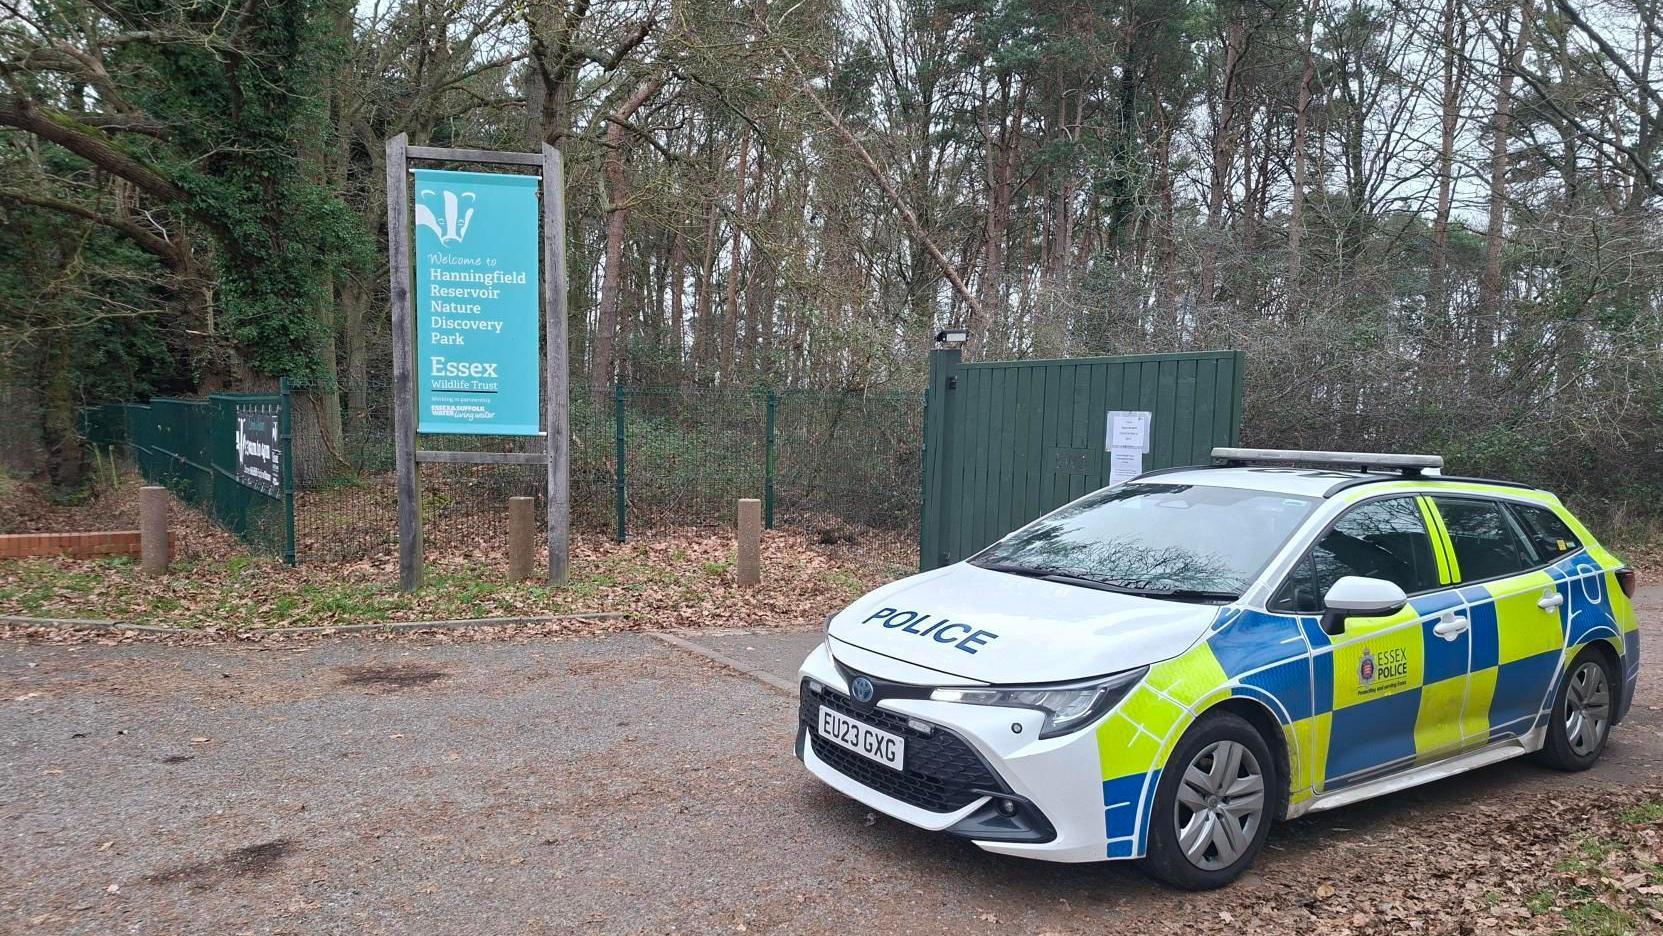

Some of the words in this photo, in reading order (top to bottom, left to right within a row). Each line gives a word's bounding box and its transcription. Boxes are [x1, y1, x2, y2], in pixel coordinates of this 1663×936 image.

[427, 252, 481, 265] Welcome
[486, 257, 497, 266] to
[430, 268, 526, 286] Hanningfield
[430, 284, 500, 299] Reservoir
[431, 300, 481, 314] Nature
[431, 316, 503, 334] Discovery
[431, 332, 465, 345] Park
[430, 356, 498, 378] Essex
[432, 379, 469, 389] Wildlife
[471, 380, 498, 390] Trust
[862, 607, 999, 655] POLICE
[1377, 648, 1407, 666] ESSEX
[1377, 663, 1407, 680] POLICE
[823, 713, 859, 748] EU23
[863, 728, 896, 763] GXG
